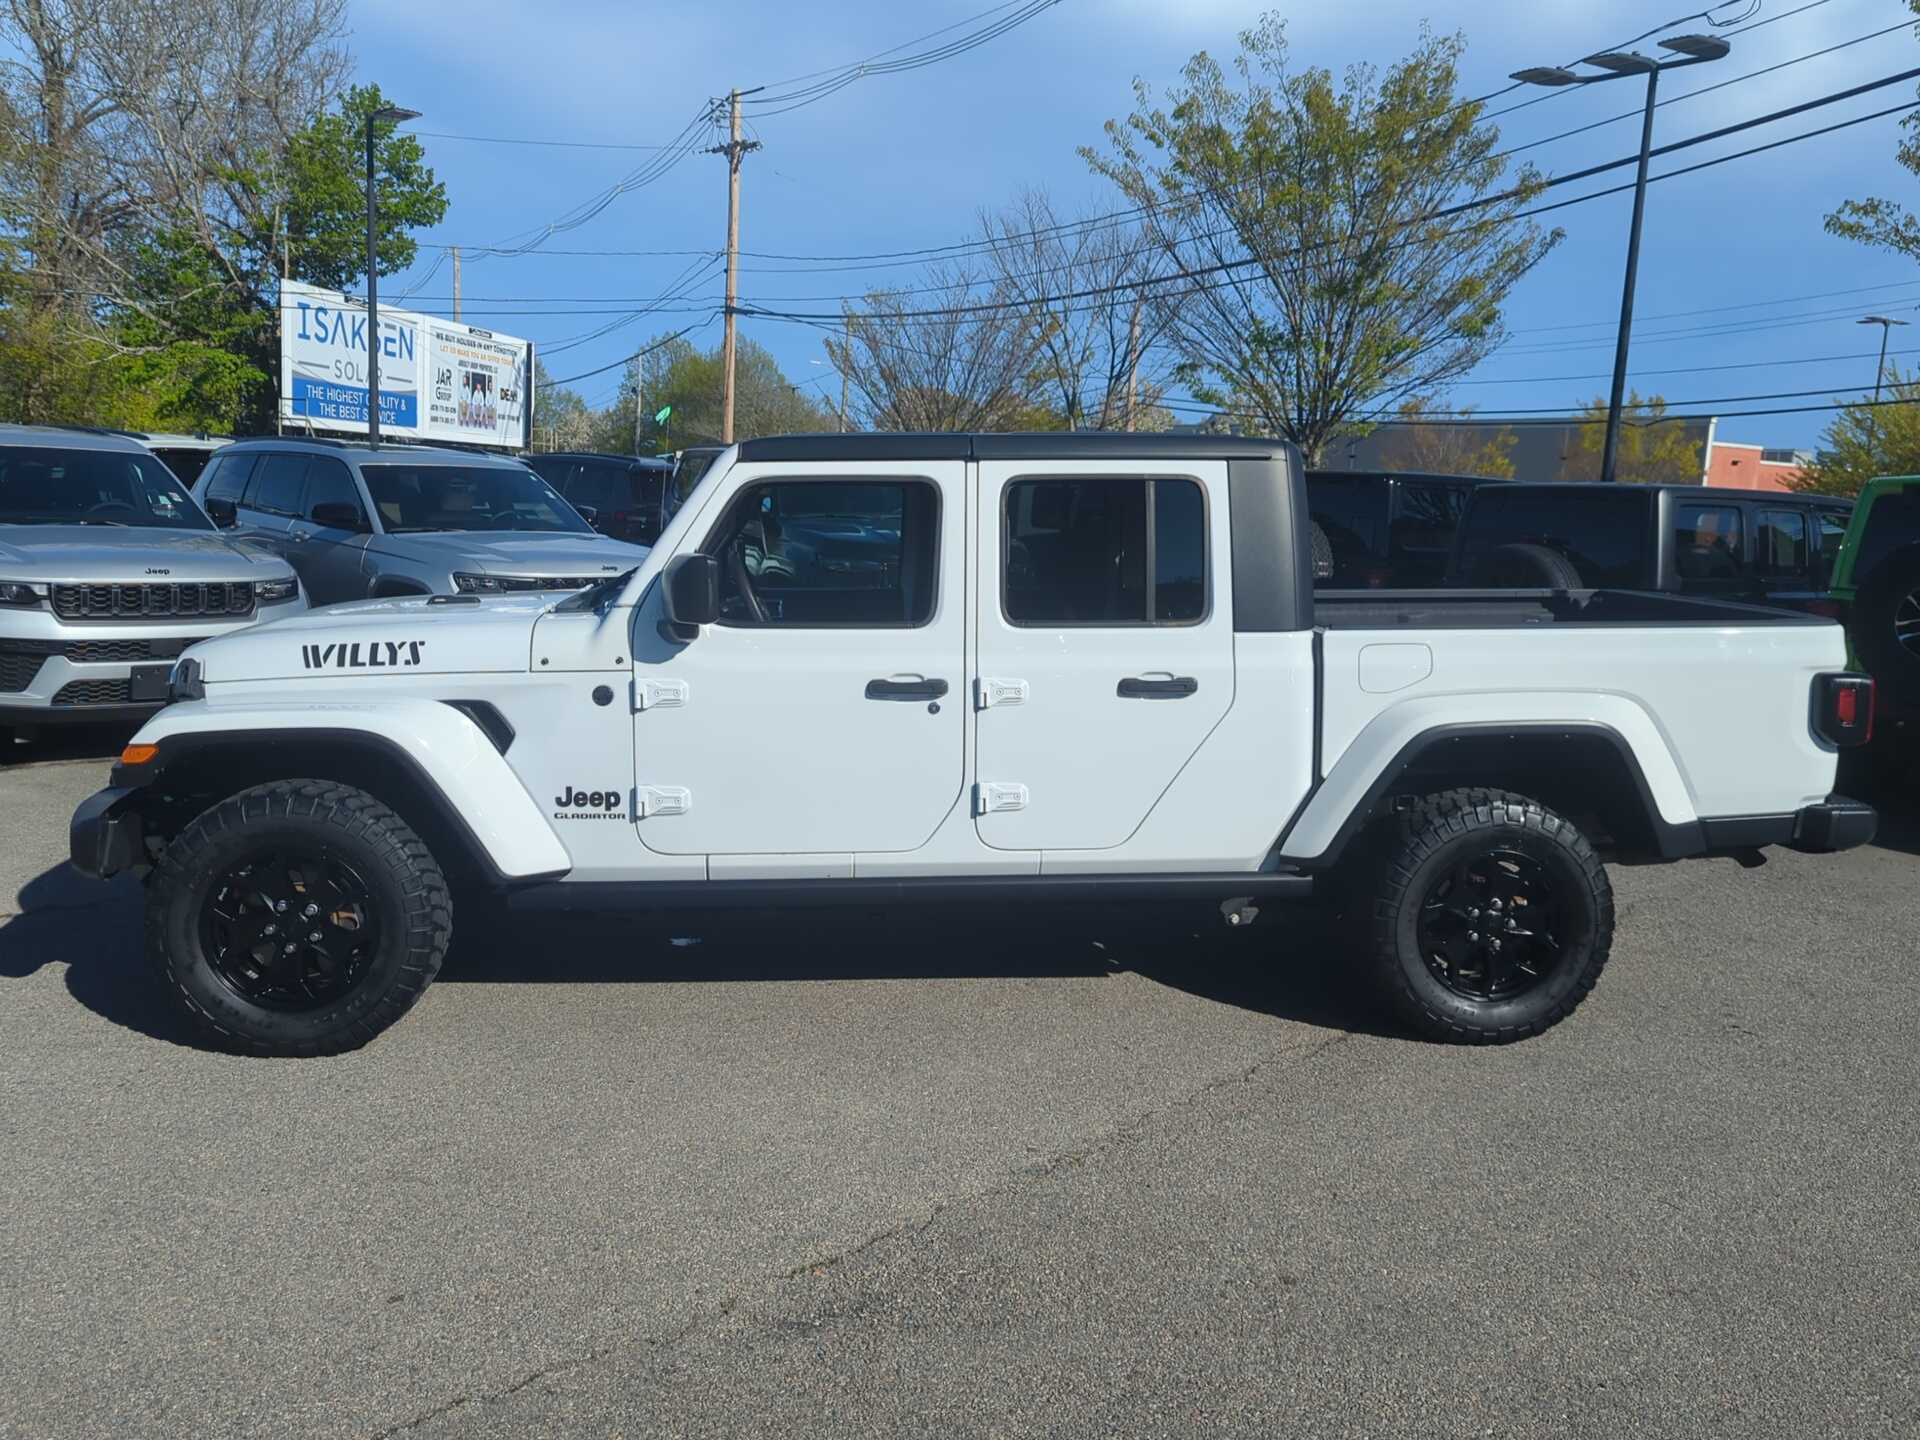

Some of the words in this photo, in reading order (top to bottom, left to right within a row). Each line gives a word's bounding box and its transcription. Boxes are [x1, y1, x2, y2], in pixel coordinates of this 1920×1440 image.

[436, 332, 444, 341] WE
[445, 334, 455, 344] BUY
[456, 338, 476, 349] HOUSES
[476, 342, 483, 350] IN
[483, 344, 493, 352] ANY
[494, 346, 518, 357] CONDITION
[440, 345, 449, 353] LET
[457, 348, 470, 357] MAKE
[470, 352, 480, 360] YOU
[436, 367, 453, 387] JAR
[306, 384, 326, 400] THE
[327, 387, 364, 406] HIGHEST
[365, 393, 400, 410] QALITY
[400, 399, 407, 412] &
[319, 402, 337, 418] THE
[339, 404, 360, 420] BEST
[363, 408, 396, 424] SVICE
[144, 567, 170, 576] Jeep
[302, 640, 426, 669] WILLYS
[555, 786, 621, 812] Jeep
